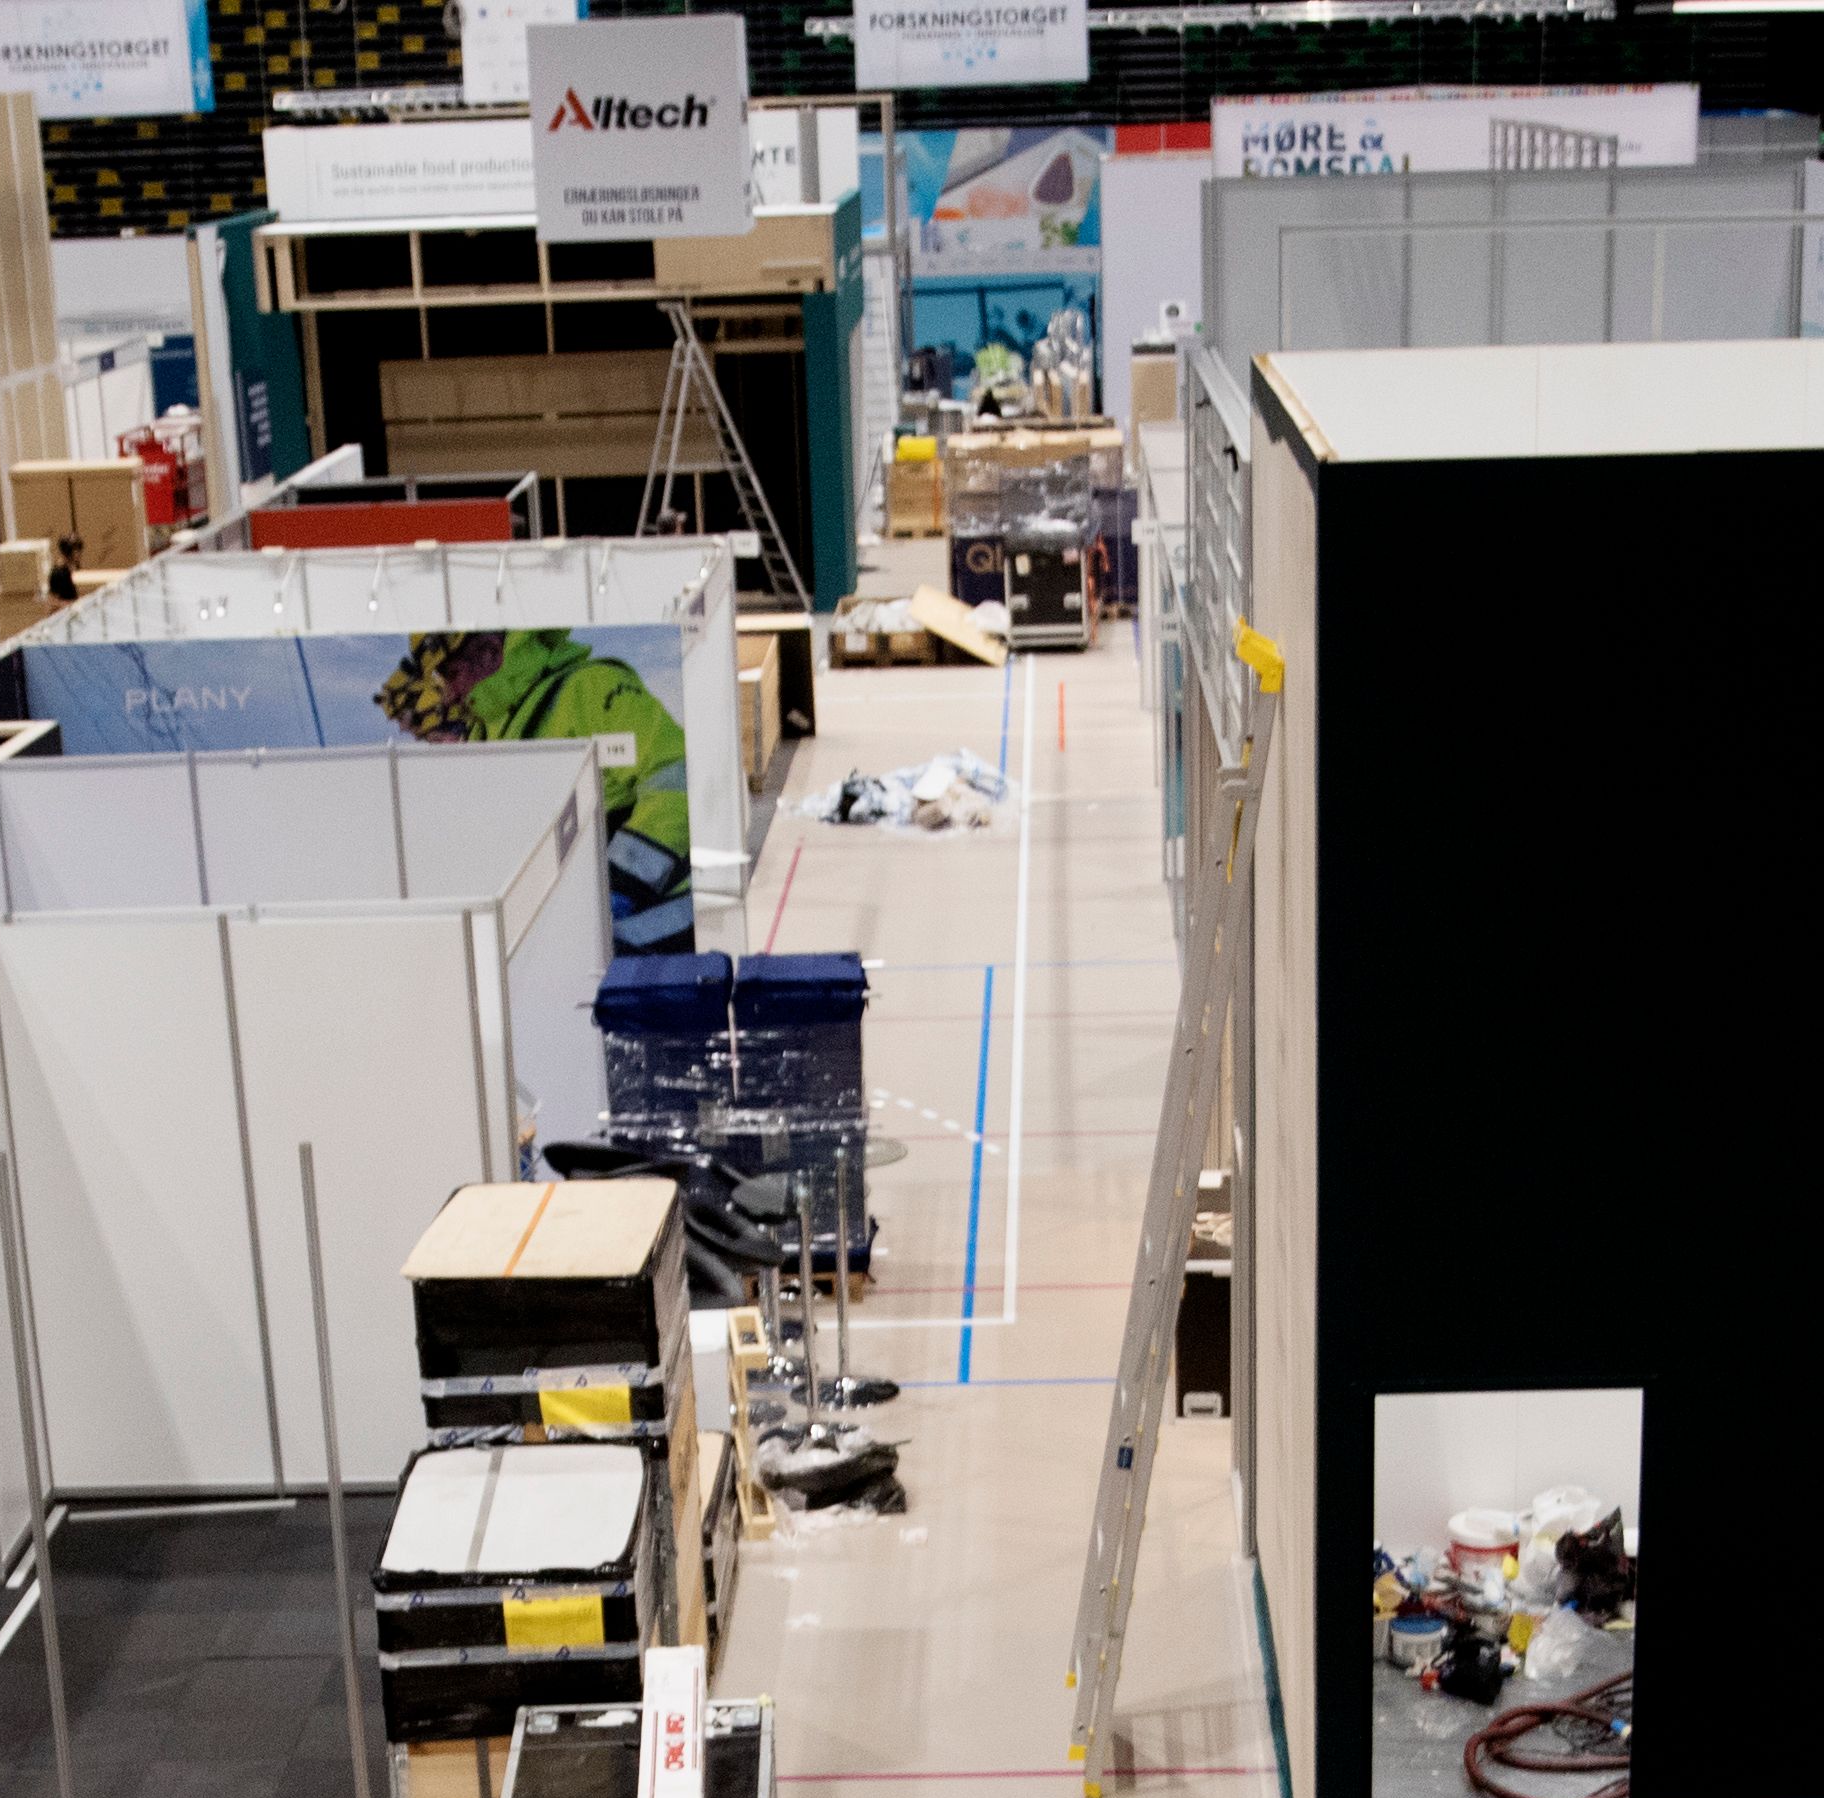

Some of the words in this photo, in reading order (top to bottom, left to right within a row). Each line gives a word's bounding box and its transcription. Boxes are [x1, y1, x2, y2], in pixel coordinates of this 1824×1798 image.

[869, 6, 1068, 30] FORSKNINGSTORGET
[548, 87, 708, 132] Alltech
[629, 207, 664, 223] STOLE
[124, 687, 253, 715] PLANY
